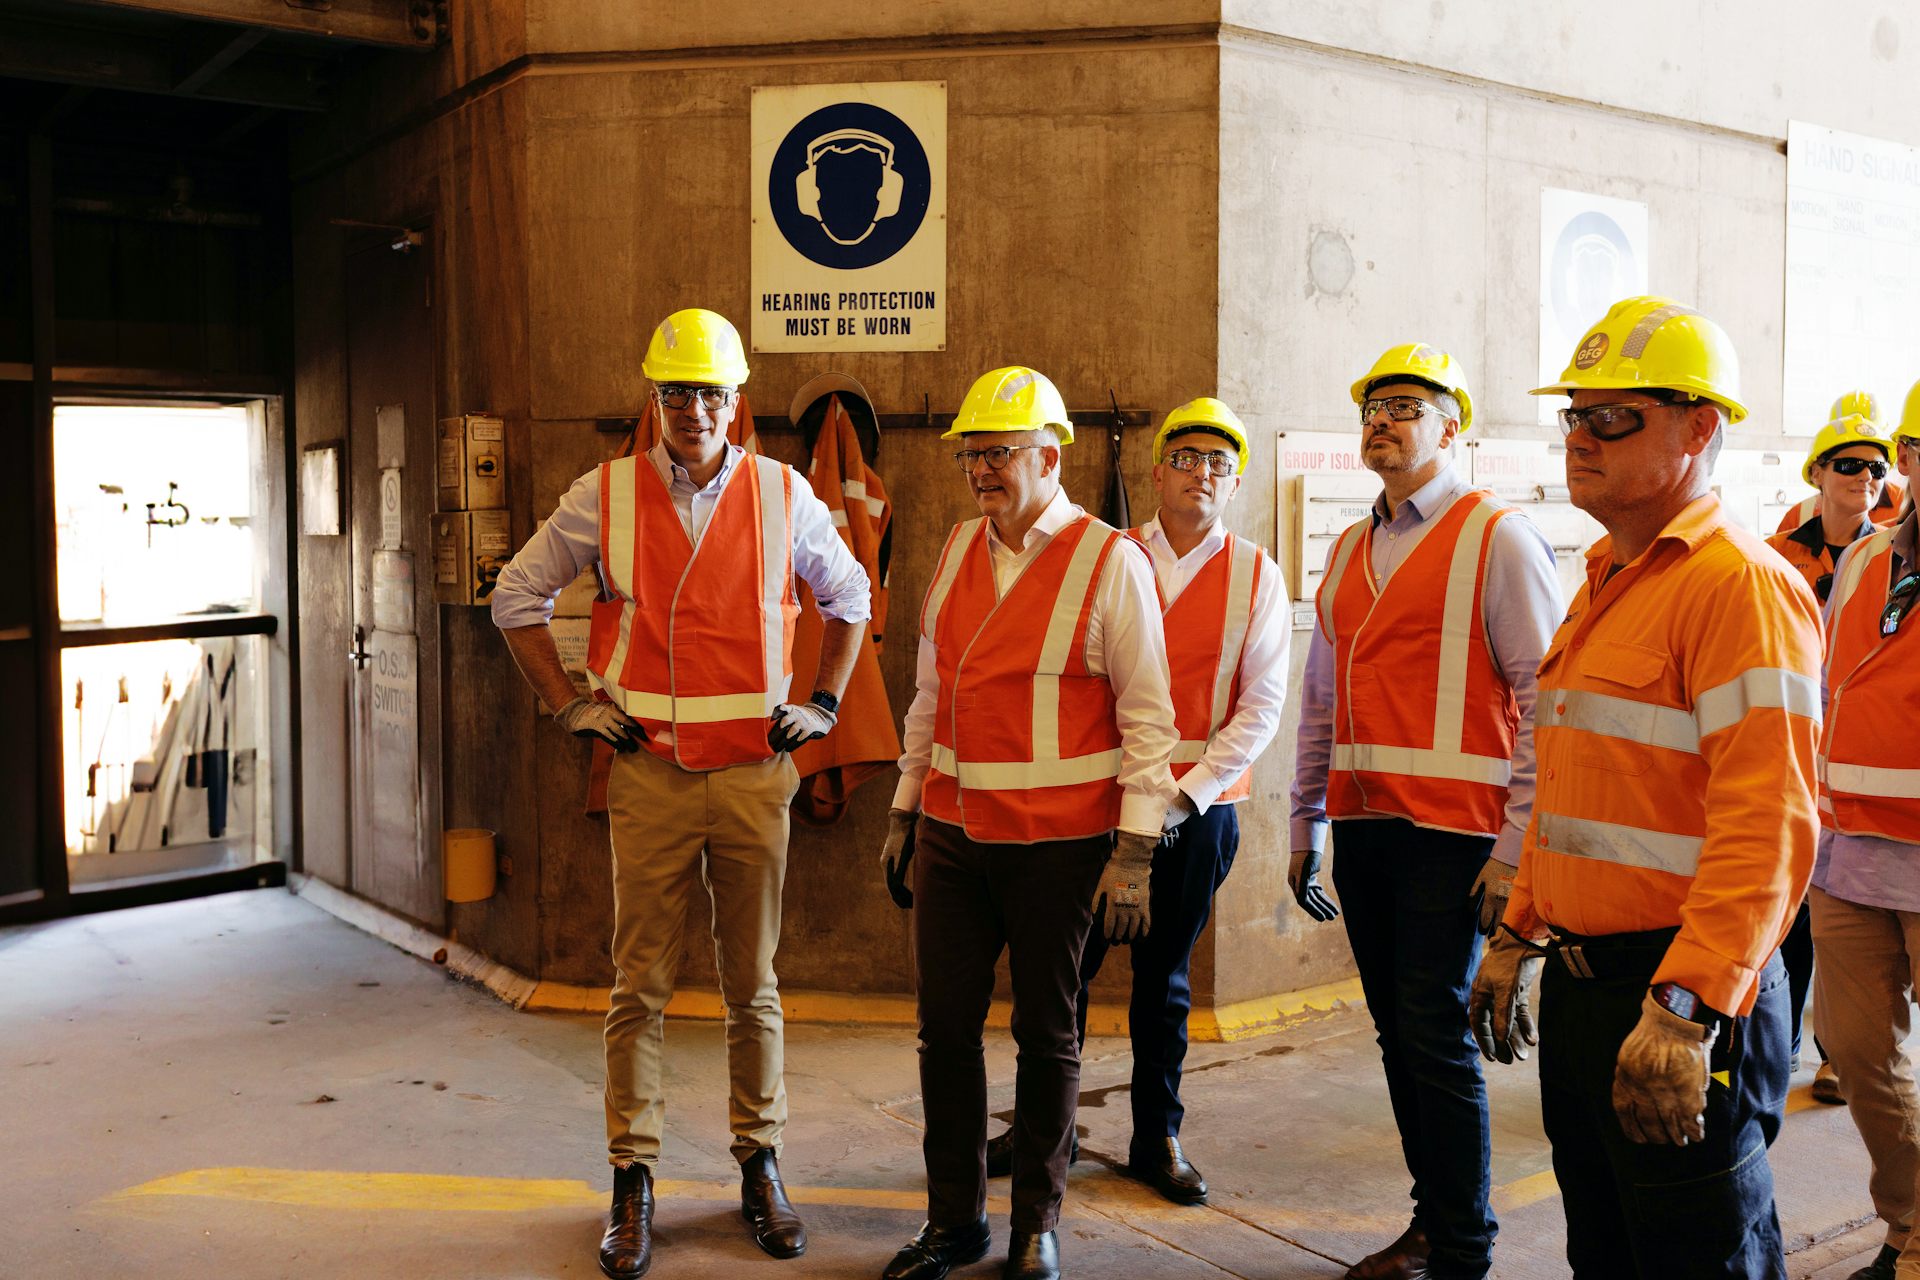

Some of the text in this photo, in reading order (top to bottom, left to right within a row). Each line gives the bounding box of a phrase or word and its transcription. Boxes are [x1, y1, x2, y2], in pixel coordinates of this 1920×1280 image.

[1803, 139, 1854, 173] HAND
[1835, 199, 1864, 216] HAND
[1832, 215, 1868, 235] SIGNAL
[762, 291, 935, 312] HEARING PROTECTION
[786, 317, 911, 336] MUST BE WORN
[1577, 347, 1602, 361] GFG
[1284, 451, 1325, 470] GROUP
